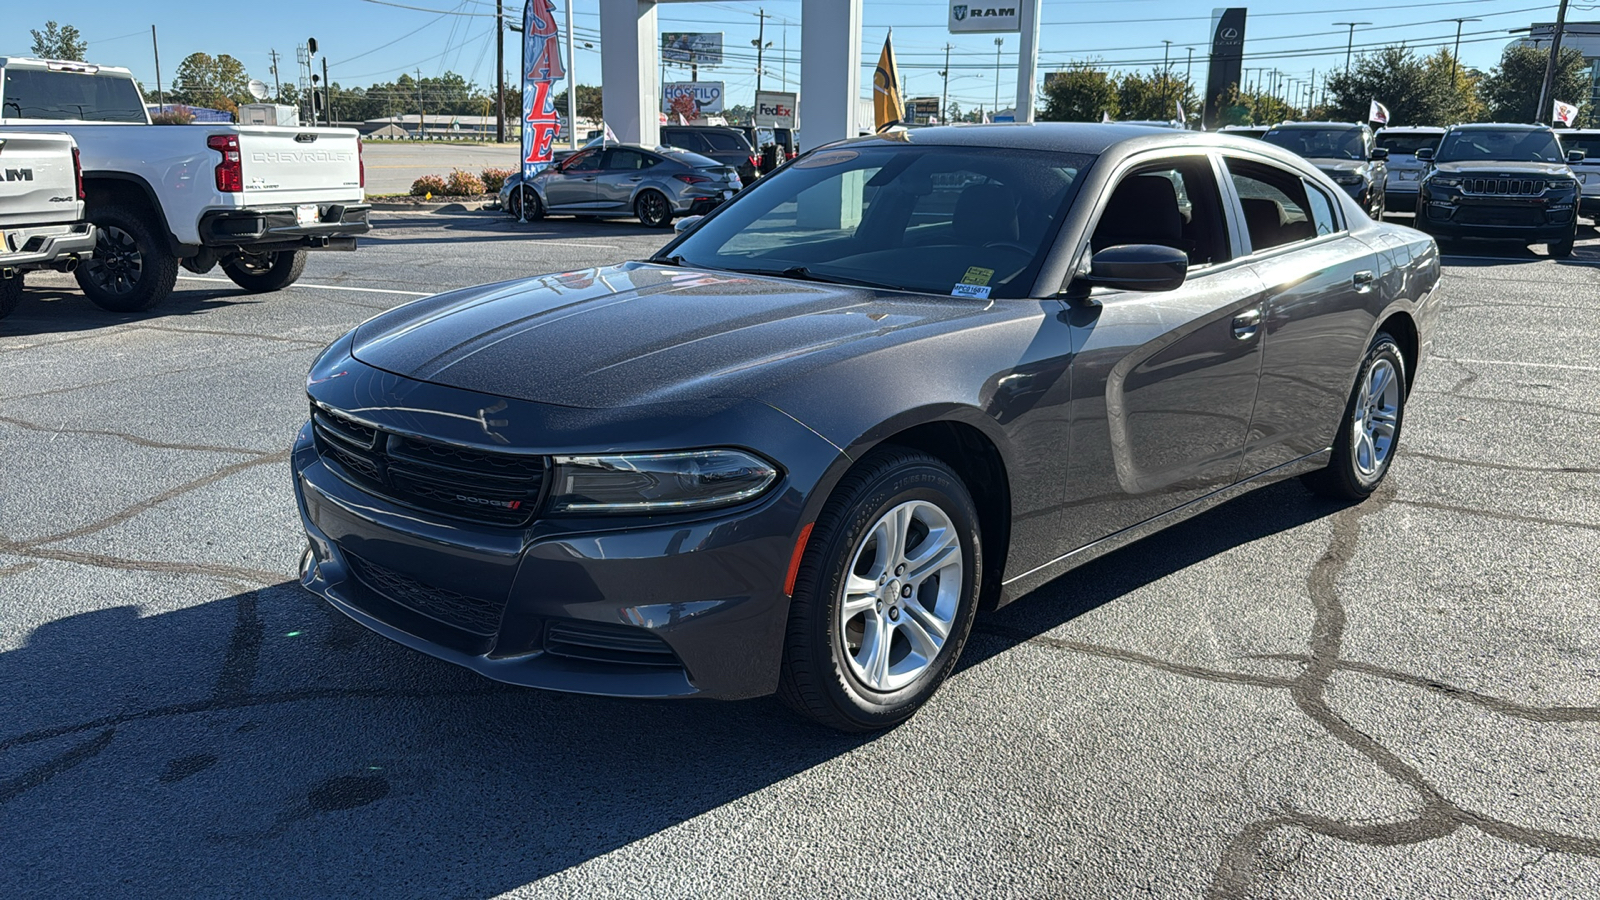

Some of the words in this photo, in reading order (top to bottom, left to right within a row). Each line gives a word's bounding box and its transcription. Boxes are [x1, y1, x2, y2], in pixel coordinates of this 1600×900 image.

[970, 8, 1015, 17] RAM
[525, 0, 567, 164] SALE
[664, 87, 720, 99] HOSTILO
[759, 103, 792, 117] FedEx
[252, 152, 354, 163] CHEVROLET
[0, 168, 34, 181] M
[921, 473, 936, 482] R17
[456, 494, 512, 508] DODGE
